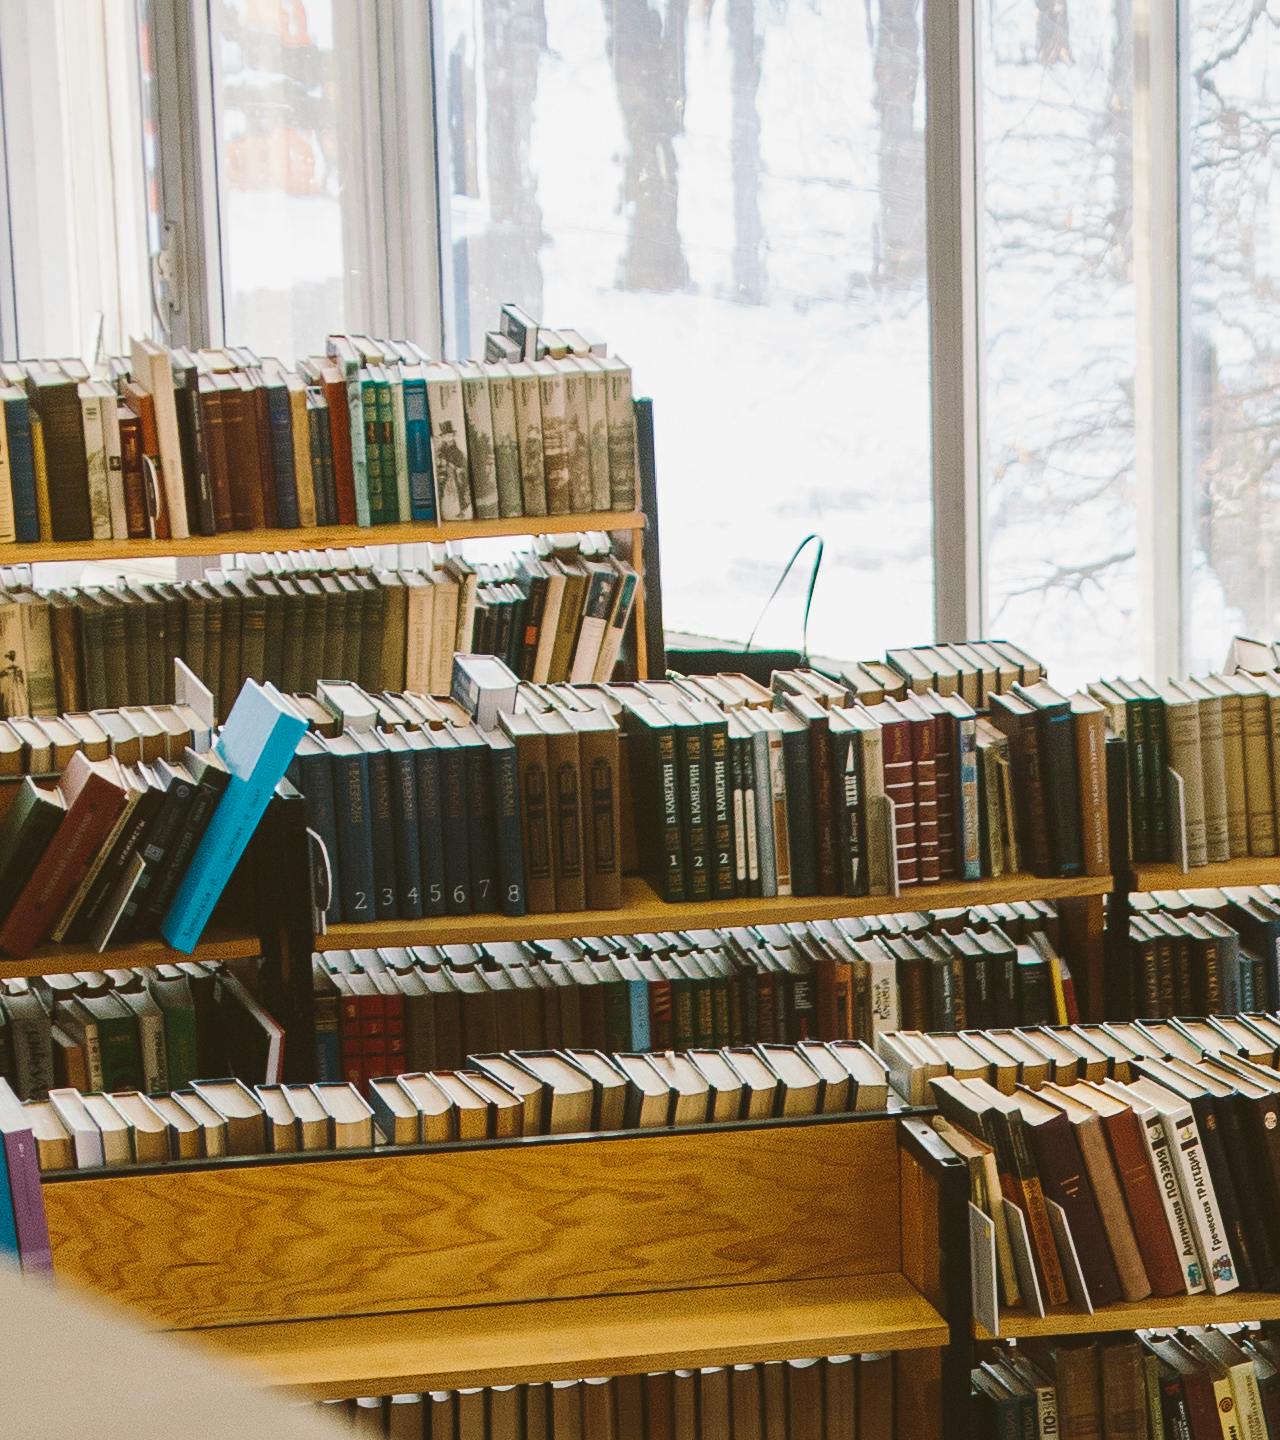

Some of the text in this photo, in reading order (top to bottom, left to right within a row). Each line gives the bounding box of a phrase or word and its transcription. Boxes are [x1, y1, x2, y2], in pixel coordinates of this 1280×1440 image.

[663, 763, 674, 814] КАВЕРИН
[690, 763, 701, 814] КАВЕРИН
[715, 760, 726, 811] КАВЕРИН
[382, 888, 395, 906] 3
[406, 887, 418, 904] 4
[429, 883, 441, 902] 5
[452, 884, 467, 904] 6
[478, 878, 491, 898] 7
[507, 884, 520, 903] 8
[353, 891, 368, 910] 2
[1156, 1148, 1194, 1256] Античная ПОЭЗИЯ
[1186, 1149, 1222, 1251] Греческая ТРАГЕДИЯ
